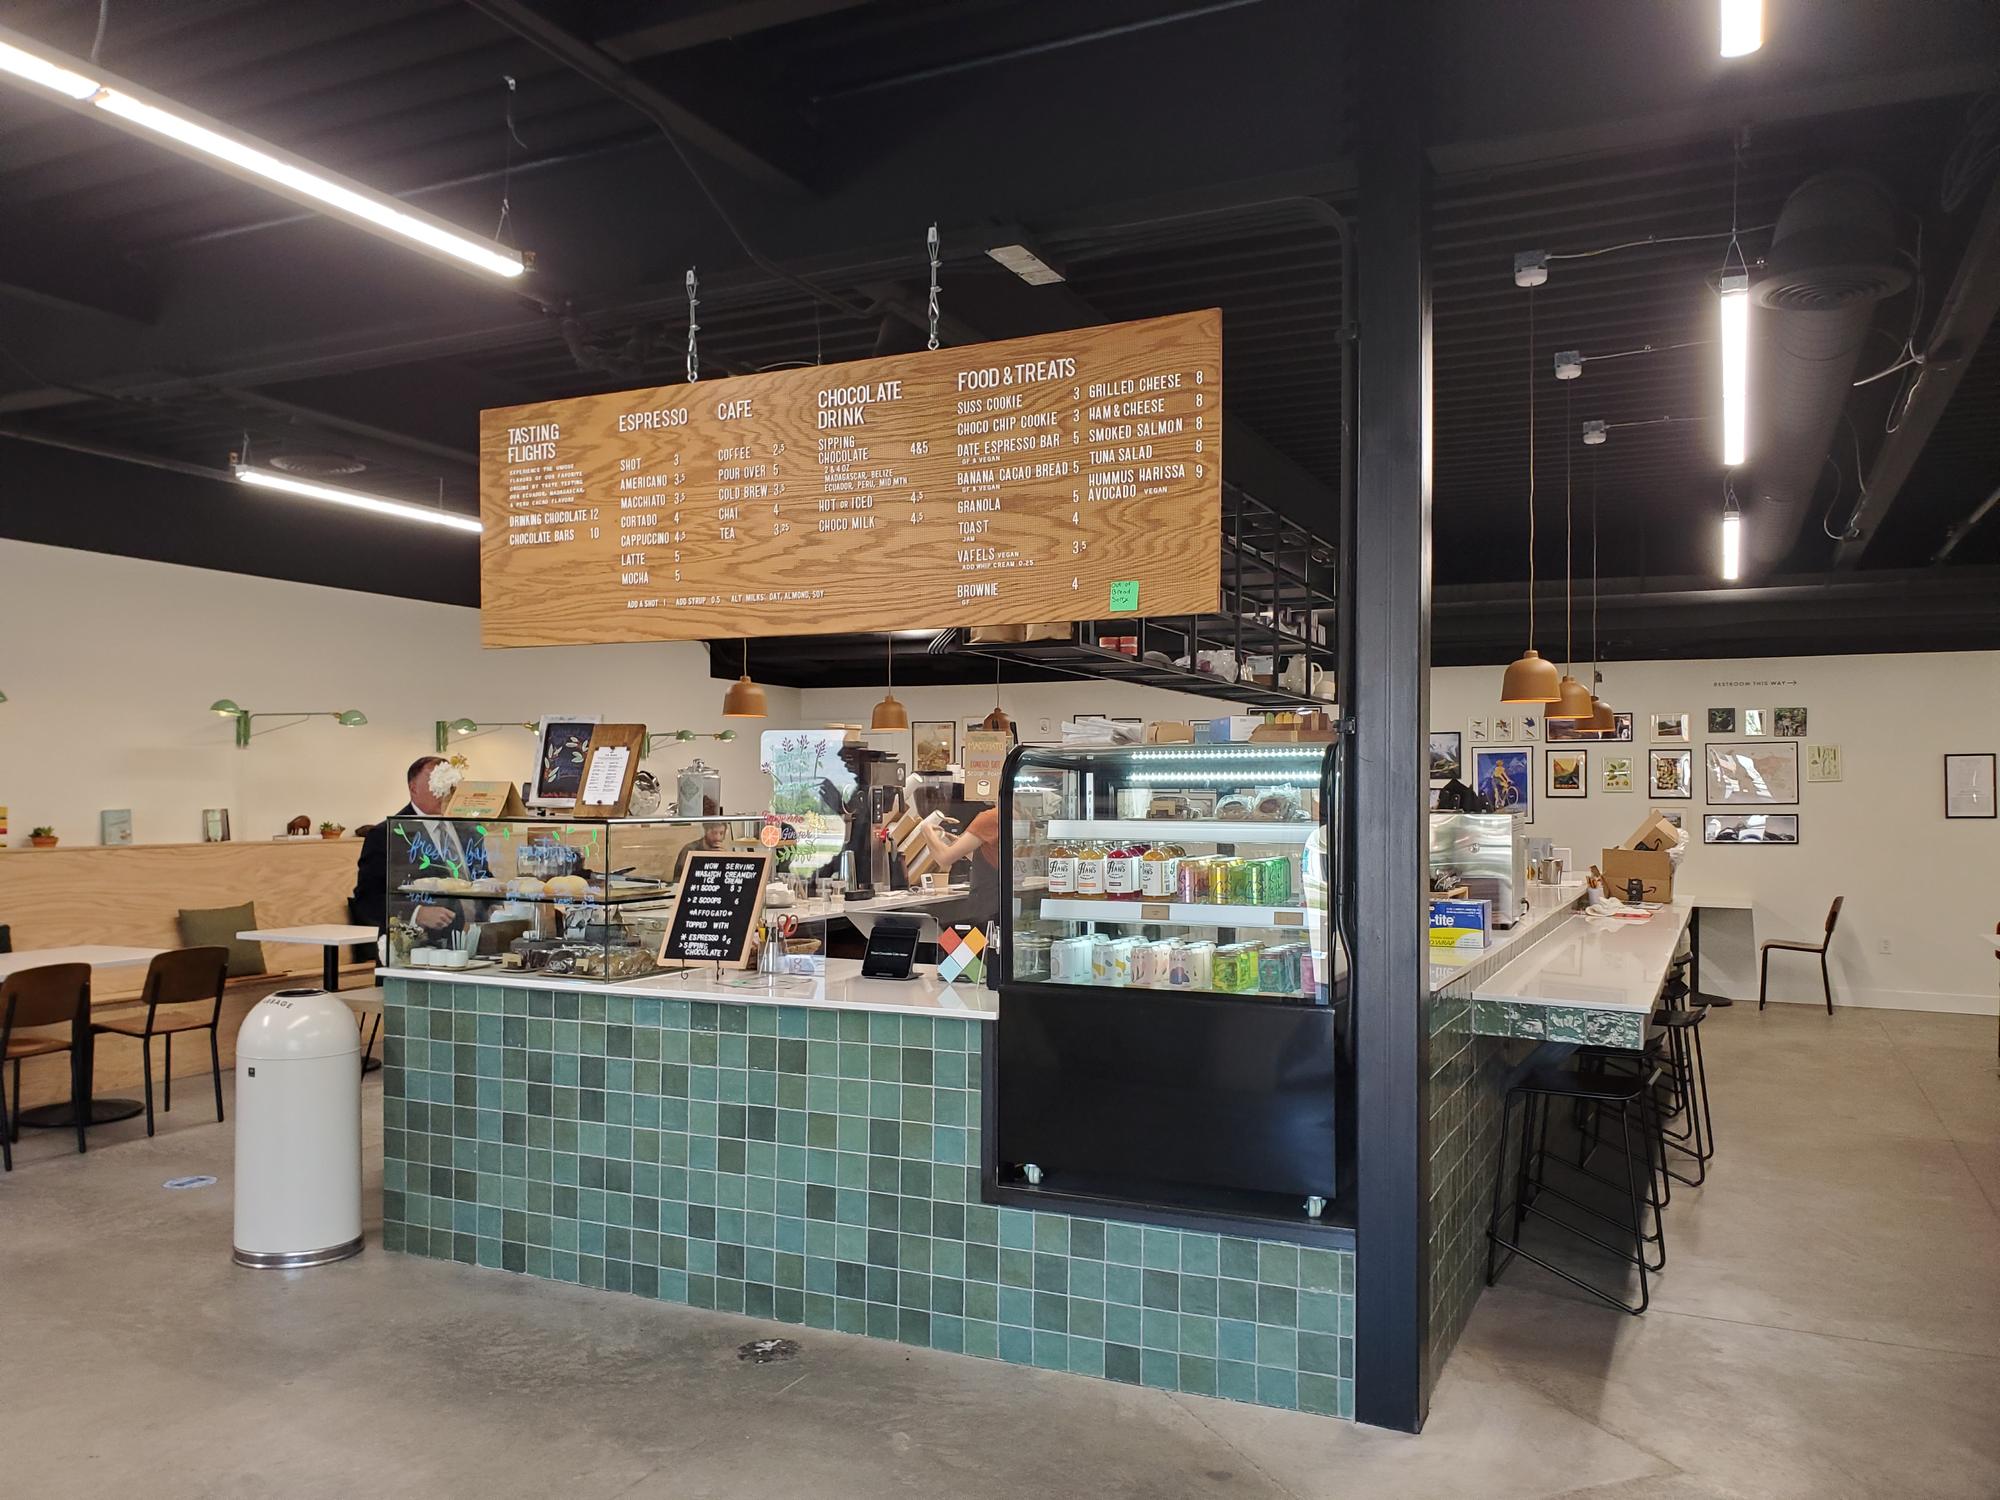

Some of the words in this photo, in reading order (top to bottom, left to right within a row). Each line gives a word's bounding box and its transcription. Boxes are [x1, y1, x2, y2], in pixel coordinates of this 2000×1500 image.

[958, 368, 999, 391] FOOD
[1003, 367, 1013, 385] &
[1015, 358, 1075, 383] TREATS
[1089, 380, 1134, 398] GRILLED
[1140, 374, 1181, 392] CHEESE
[1196, 370, 1203, 385] 8
[818, 381, 902, 408] CHOCOLATE
[958, 400, 982, 414] SUSS
[987, 394, 1022, 410] COOKIE
[1074, 387, 1079, 400] 3
[718, 400, 752, 420] CAFE
[1089, 405, 1111, 420] HAM
[1114, 404, 1120, 417] &
[1124, 398, 1164, 416] CHEESE
[1196, 394, 1202, 408] 8
[619, 408, 688, 432] ESPRESSO
[818, 406, 864, 429] DRINK
[958, 420, 988, 435] CHOCO
[993, 417, 1016, 432] CHIP
[1021, 412, 1057, 428] COOKIE
[1073, 409, 1079, 422] 3
[508, 424, 559, 445] TASTING
[1089, 424, 1132, 442] SMOKED
[1137, 418, 1183, 436] SALMON
[1196, 417, 1202, 430] 8
[819, 436, 854, 451] SIPPING
[819, 448, 868, 464] CHOCOLATE
[910, 441, 928, 455] 4&5
[958, 442, 980, 456] DATE
[984, 436, 1036, 454] ESPRESSO
[1040, 434, 1060, 448] BAR
[1073, 431, 1079, 444] 5
[1089, 450, 1115, 464] TUNA
[1119, 445, 1152, 461] SALAD
[1196, 440, 1202, 453] 8
[508, 443, 556, 463] FLIGHTS
[718, 447, 751, 461] COFFEE
[620, 458, 641, 471] SHOT
[674, 454, 679, 466] 3
[719, 468, 740, 481] POUR
[744, 465, 766, 478] OVER
[773, 464, 778, 476] 5
[871, 469, 893, 478] BELIZE
[958, 470, 994, 485] BANANA
[1000, 466, 1031, 481] CACAO
[1036, 462, 1068, 477] BREAD
[1073, 461, 1079, 473] 5
[1089, 470, 1134, 487] HUMMUS
[1140, 464, 1184, 482] HARISSA
[1196, 464, 1202, 478] 9
[620, 475, 667, 490] AMERICANO
[621, 494, 665, 509] MACCHIATO
[719, 488, 739, 500] COLD
[744, 485, 768, 498] BREW
[958, 498, 1000, 513] GRANOLA
[1073, 490, 1079, 502] 5
[1088, 484, 1136, 501] AVOCADO
[1144, 486, 1168, 494] VEGAN
[719, 507, 738, 520] CHAI
[774, 504, 779, 516] 4
[819, 499, 836, 512] HOT
[852, 496, 872, 508] ICED
[510, 513, 541, 527] DRINKING
[545, 510, 587, 524] CHOCOLATE
[590, 508, 599, 520] 12
[621, 514, 657, 528] CORTADO
[674, 512, 679, 524] 4
[819, 518, 848, 532] CHOCO
[852, 516, 875, 529] MILK
[958, 520, 989, 534] TOAST
[1073, 512, 1078, 525] 4
[510, 531, 551, 545] CHOCOLATE
[554, 529, 574, 541] BARS
[591, 527, 600, 539] 10
[621, 532, 670, 547] CAPPUCCINO
[720, 527, 735, 539] TEA
[621, 553, 645, 566] LATTE
[675, 550, 679, 562] 5
[957, 548, 995, 562] VAFELS
[622, 571, 648, 584] MOCHA
[675, 570, 680, 581] 5
[957, 583, 998, 598] BROWNIE
[1072, 577, 1078, 590] 4
[627, 600, 638, 608] ADD
[645, 600, 658, 608] SHOT
[731, 595, 742, 603] ALT
